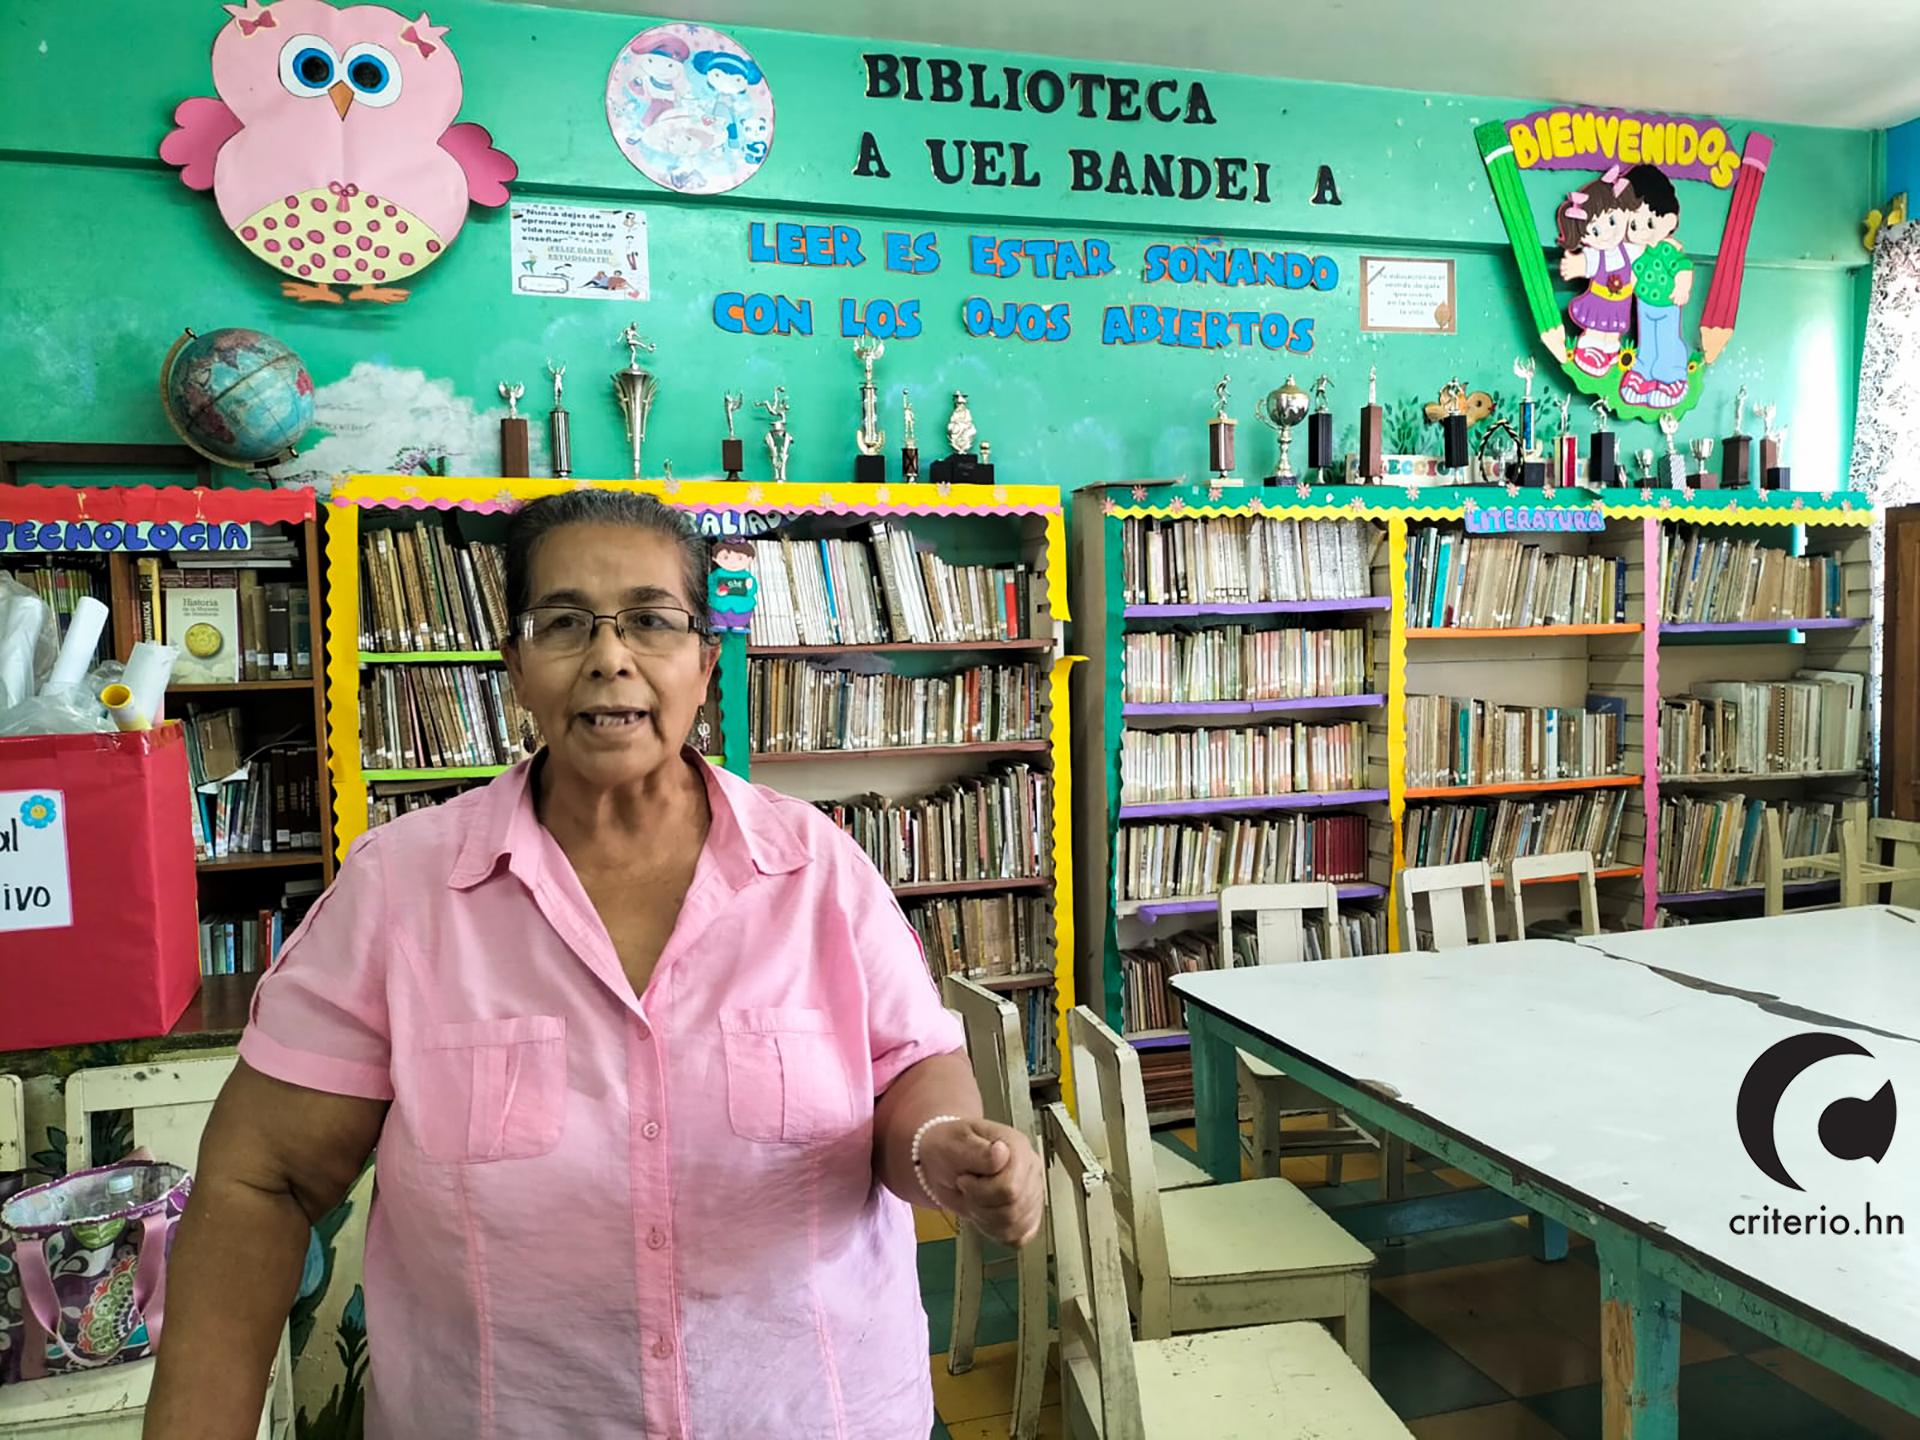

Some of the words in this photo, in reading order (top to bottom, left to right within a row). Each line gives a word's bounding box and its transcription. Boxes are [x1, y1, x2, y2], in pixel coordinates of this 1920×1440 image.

[862, 53, 1217, 125] BIBLIOTECA
[925, 138, 1041, 187] UEL
[1509, 111, 1740, 188] BIENVENIDOS
[521, 218, 567, 226] aprender
[570, 222, 604, 230] porque
[545, 228, 576, 236] nunca
[578, 230, 599, 238] deja
[596, 248, 613, 256] DEL
[748, 221, 866, 268] LEER
[884, 230, 941, 275] ES
[969, 234, 1116, 281] ESTAR
[1143, 233, 1339, 292] SOÑANDO
[713, 291, 813, 337] CON
[840, 296, 922, 340] LOS
[963, 295, 1071, 343] OJOS
[1102, 304, 1316, 355] ABIERTOS
[1466, 508, 1603, 533] LITERATURA
[0, 521, 249, 551] TECNOLOGIA
[183, 597, 218, 606] Historia
[3, 883, 51, 911] ivo
